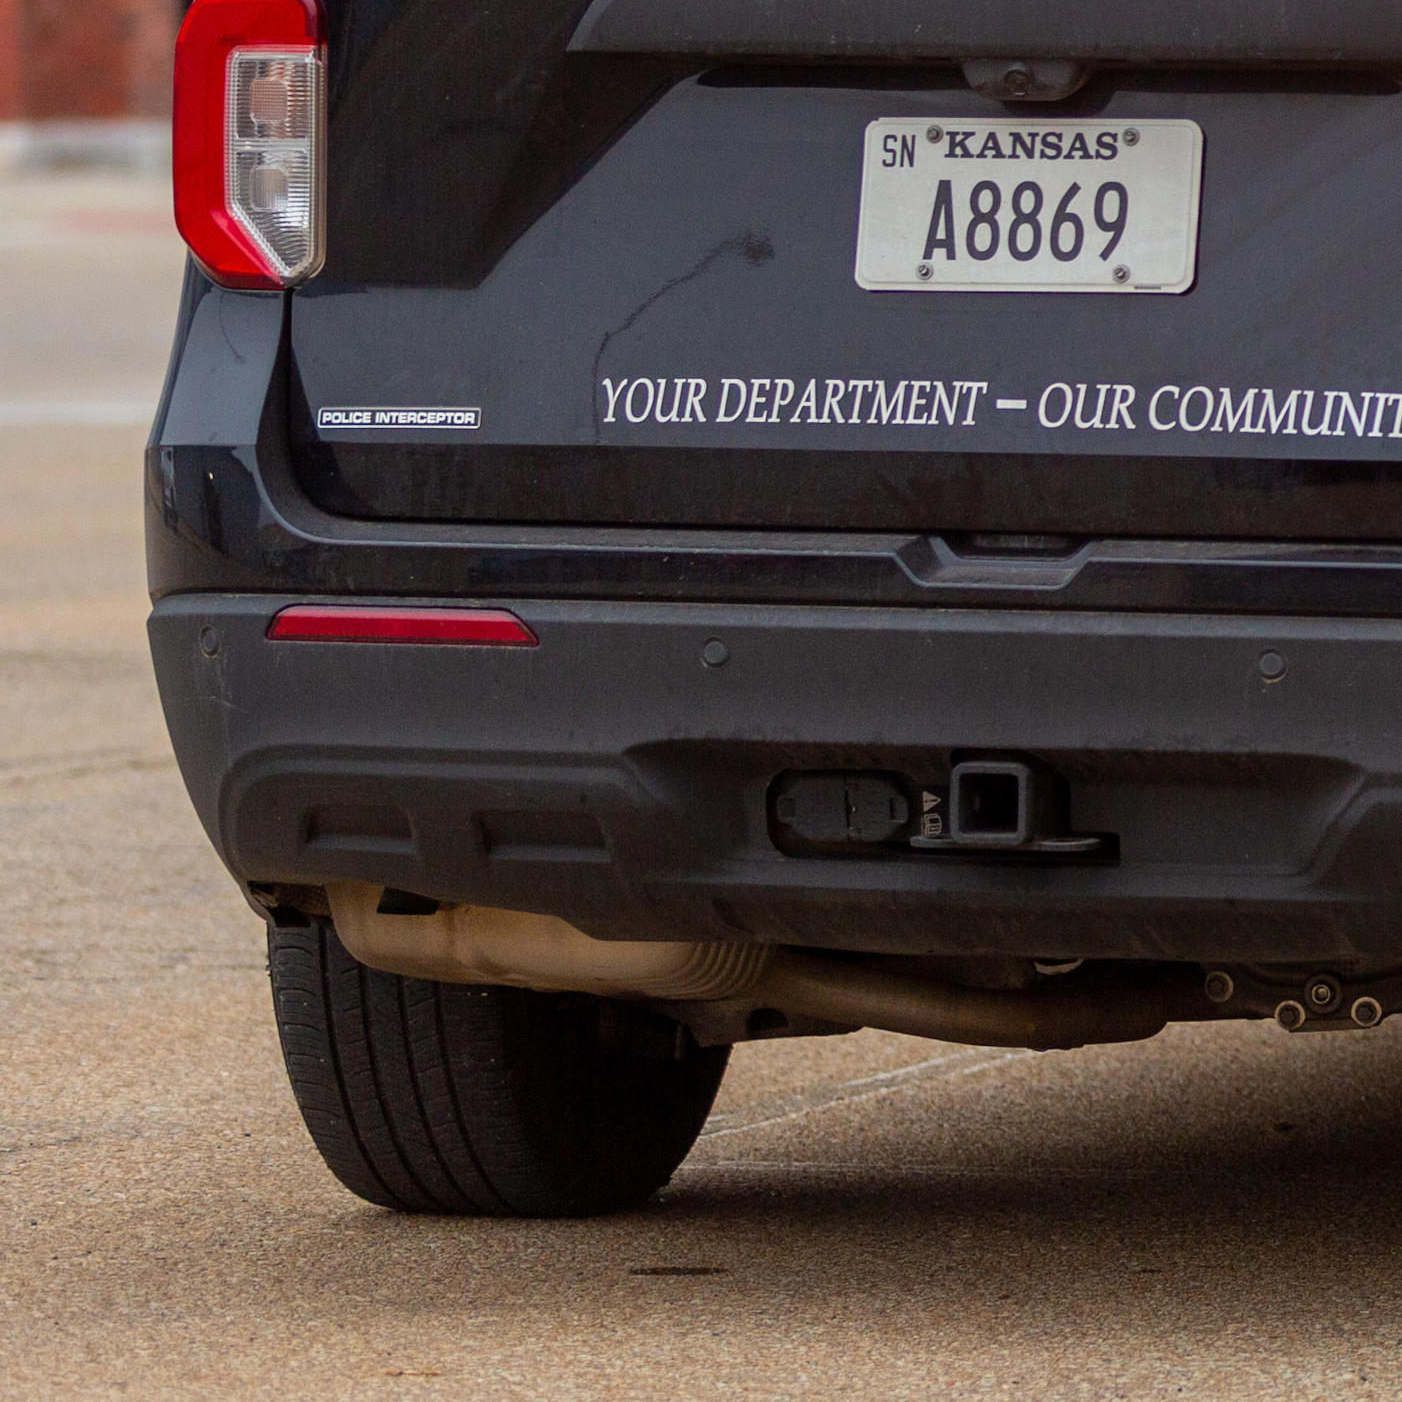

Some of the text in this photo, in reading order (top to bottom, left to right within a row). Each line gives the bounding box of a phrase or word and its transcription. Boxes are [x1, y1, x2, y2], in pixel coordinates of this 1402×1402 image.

[881, 135, 915, 168] SN
[944, 131, 1118, 161] KANSAS
[922, 179, 1129, 262] A8869
[322, 412, 475, 424] POLICE INTERCEPTOR
[601, 378, 706, 423] YOUR
[716, 379, 988, 426] DEPARTMENT
[1038, 382, 1136, 430] OUR
